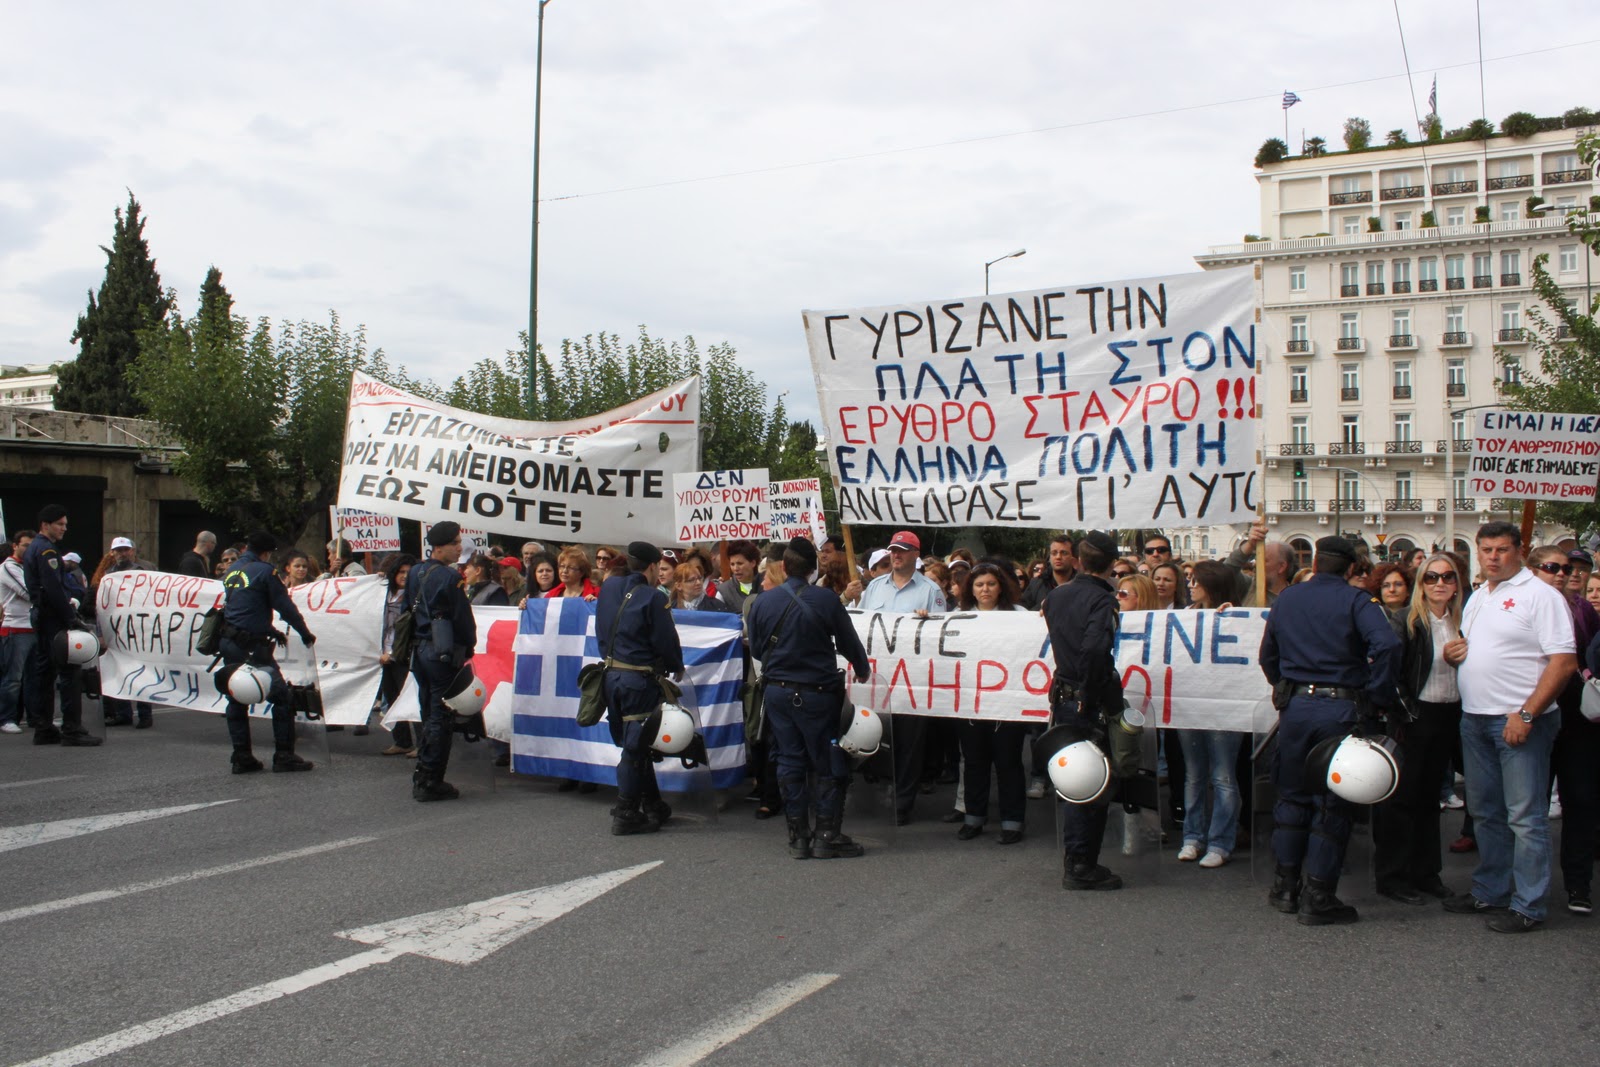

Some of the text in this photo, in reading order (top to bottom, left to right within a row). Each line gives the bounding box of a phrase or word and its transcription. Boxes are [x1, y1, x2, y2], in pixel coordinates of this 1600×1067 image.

[825, 283, 1167, 360] ΓΥΡΙΣΑΝΕ ΤΗΝ
[1108, 325, 1255, 386] ΣΤΟΝ
[840, 401, 996, 444] ΕΡΥΘΡΟ
[1484, 412, 1545, 431] ΕΙΜΑΙ
[1551, 416, 1563, 431] Η
[836, 421, 1226, 484] ΕΛΛΗΝΑ ΠΟΛΙΤΗ
[1475, 438, 1507, 453] ΤΟΥ
[385, 442, 420, 471] ΝΑ
[425, 447, 663, 498] ΑΜΕΙΒΟΜΑΣΤΕ
[1472, 457, 1506, 473] ΠΟΤΕ
[355, 474, 429, 506] ΕΩΣ
[696, 470, 743, 489] ΔΕΝ
[1471, 479, 1496, 492] ΤΟ
[1503, 479, 1537, 494] ΒΟΛΙ
[1540, 482, 1559, 495] ΤΟΥ
[676, 486, 769, 506] ΥΠΟΧΩΡΟΥΜΕ
[839, 480, 1041, 525] ΑΝΤΕΔΡΑΣΕ
[690, 505, 760, 522] ΑΝ ΔΕΝ
[800, 512, 826, 524] ΛΕΑ
[357, 528, 378, 539] ΚΑΙ
[679, 521, 772, 541] ΔΙΚΑΙΩΘΟΥΜΕ
[102, 578, 113, 609] Ο
[116, 574, 214, 609] ΕΡΥΘΡΟΣ
[847, 610, 978, 657] ΝΤΕ
[118, 664, 200, 704] ΛΥΣΗ
